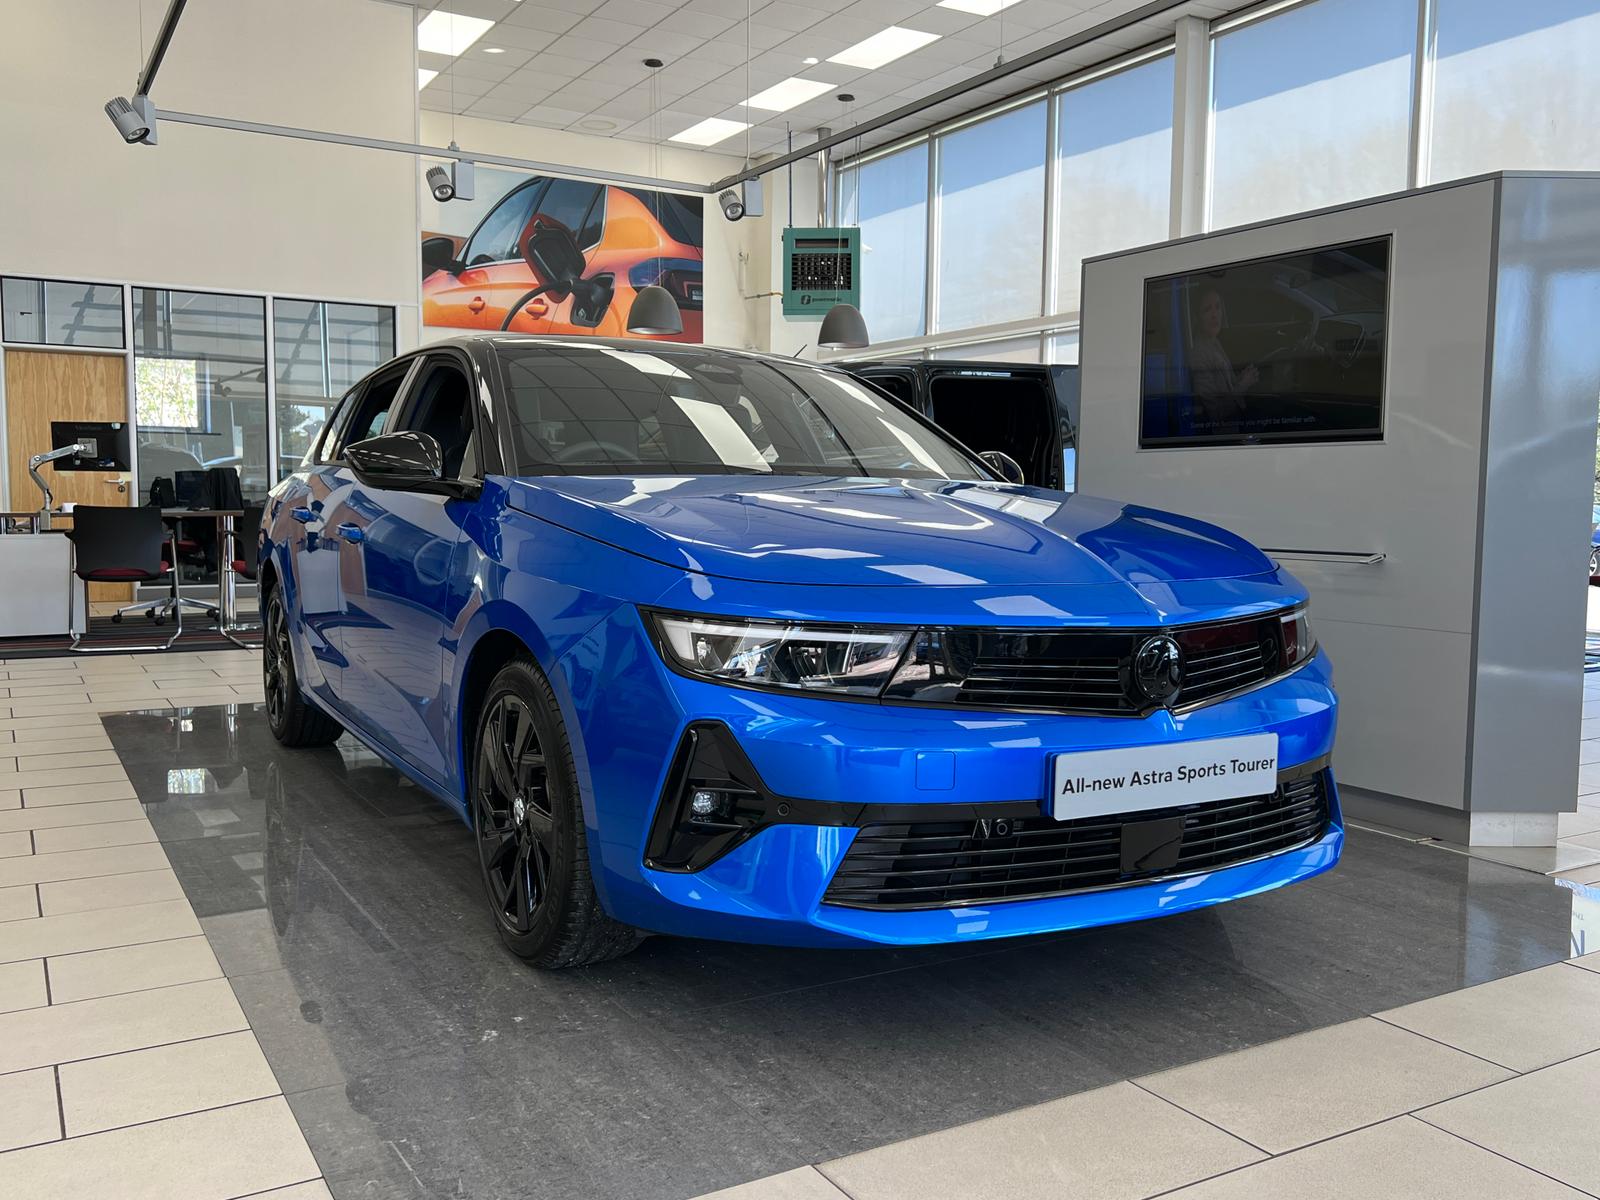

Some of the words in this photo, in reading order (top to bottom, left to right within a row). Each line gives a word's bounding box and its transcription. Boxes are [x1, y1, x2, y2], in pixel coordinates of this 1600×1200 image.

[1061, 777, 1126, 795] All-new
[1129, 771, 1173, 787] Astra
[1177, 763, 1226, 783] Sports
[1230, 758, 1275, 774] Tourer
